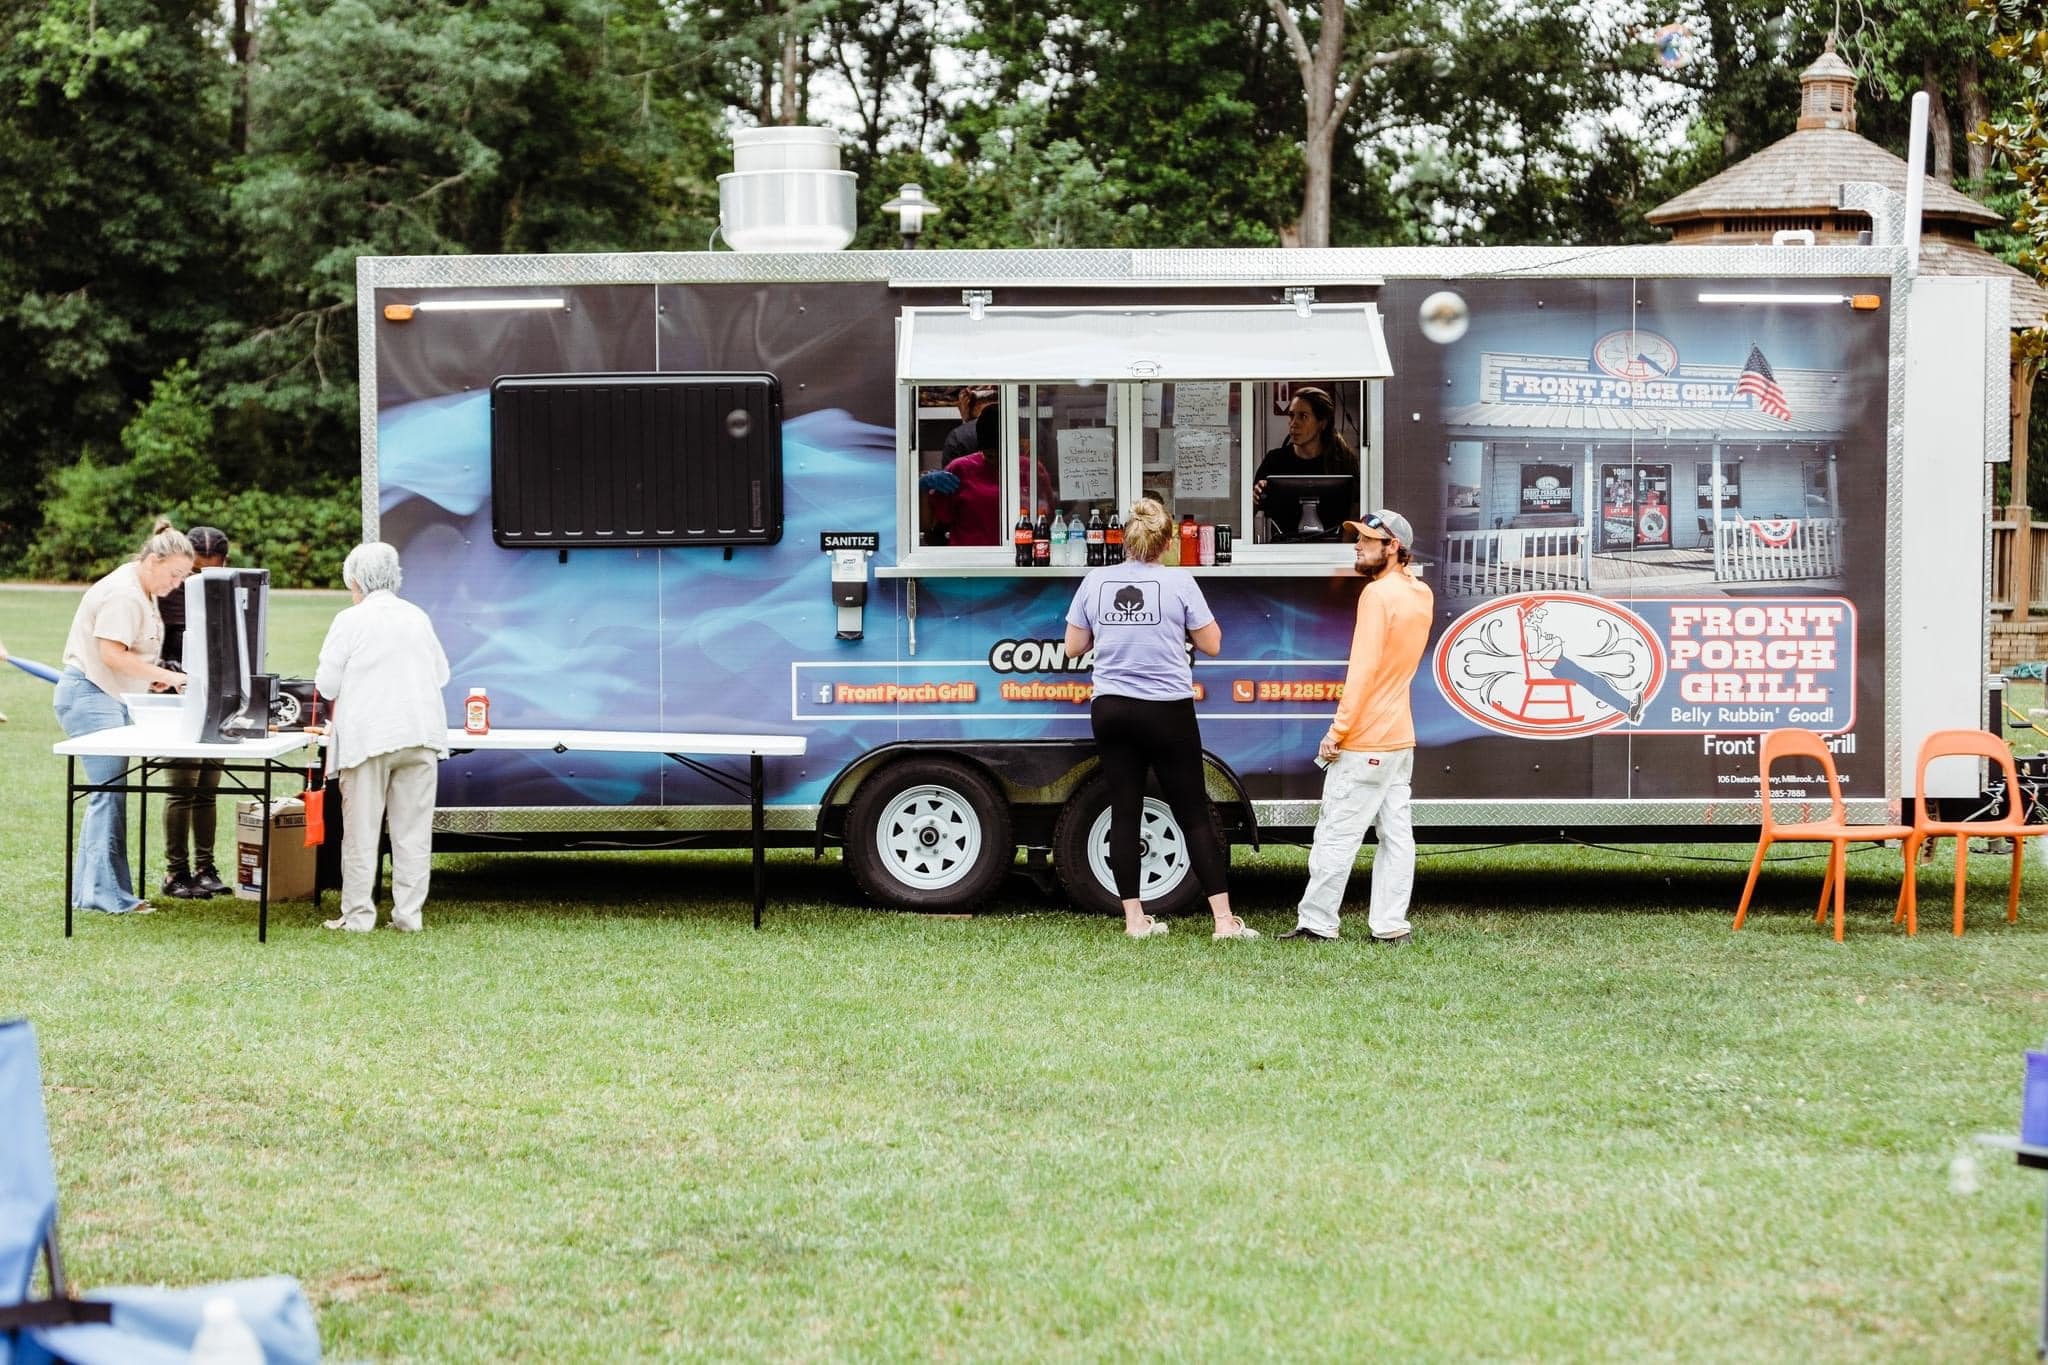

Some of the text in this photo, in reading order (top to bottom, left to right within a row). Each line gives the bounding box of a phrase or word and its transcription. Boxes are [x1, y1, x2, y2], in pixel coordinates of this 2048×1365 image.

[1505, 374, 1597, 398] FRONT
[1600, 379, 1680, 400] PORCH
[824, 536, 875, 546] SANITIZE
[1670, 606, 1843, 637] FRONT
[1670, 640, 1836, 670] PORCH
[837, 685, 882, 700] Front
[886, 684, 937, 700] Porch
[938, 683, 974, 700] Grill
[1001, 682, 1095, 702] thefrontpo
[1260, 683, 1345, 699] 334 285 78
[1680, 673, 1827, 703] GRILL
[1671, 707, 1834, 726] Belly Rubbin' Good!
[1703, 734, 1756, 755] Front
